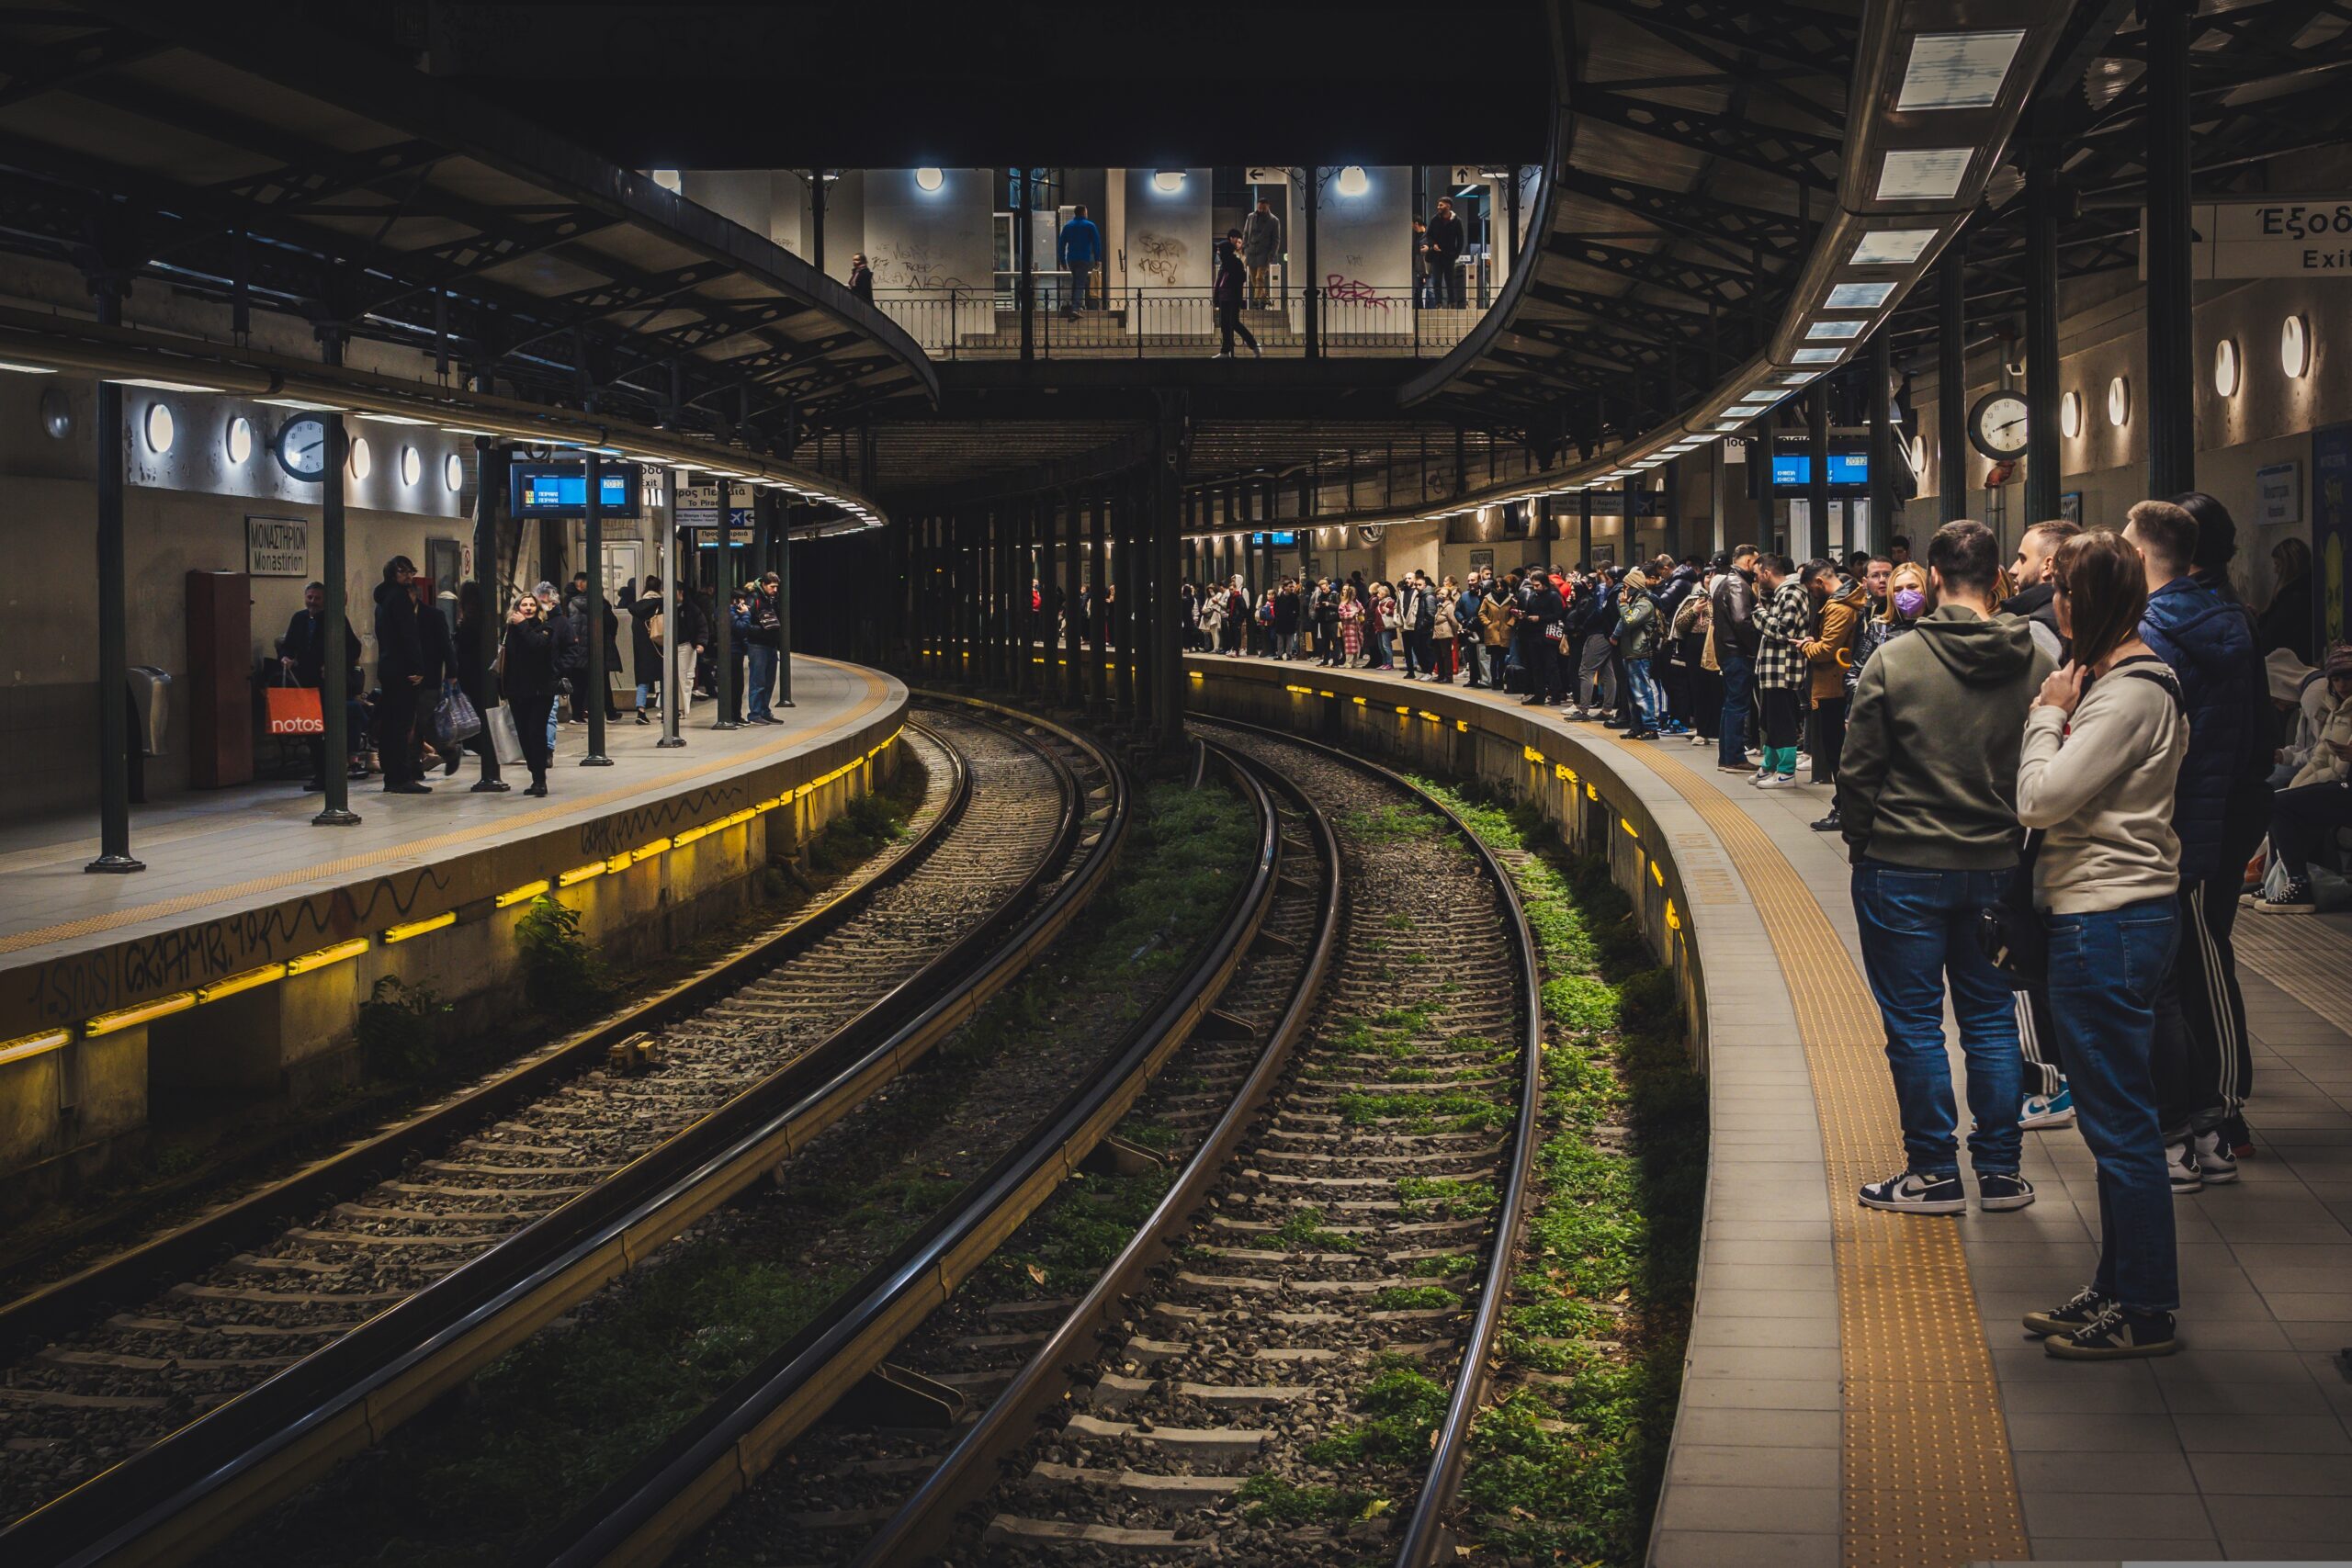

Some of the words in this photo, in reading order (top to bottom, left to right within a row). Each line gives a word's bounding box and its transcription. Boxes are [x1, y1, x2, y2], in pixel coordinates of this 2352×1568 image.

[675, 490, 698, 498] ρος
[254, 551, 302, 571] Monastirion
[272, 716, 323, 733] notos
